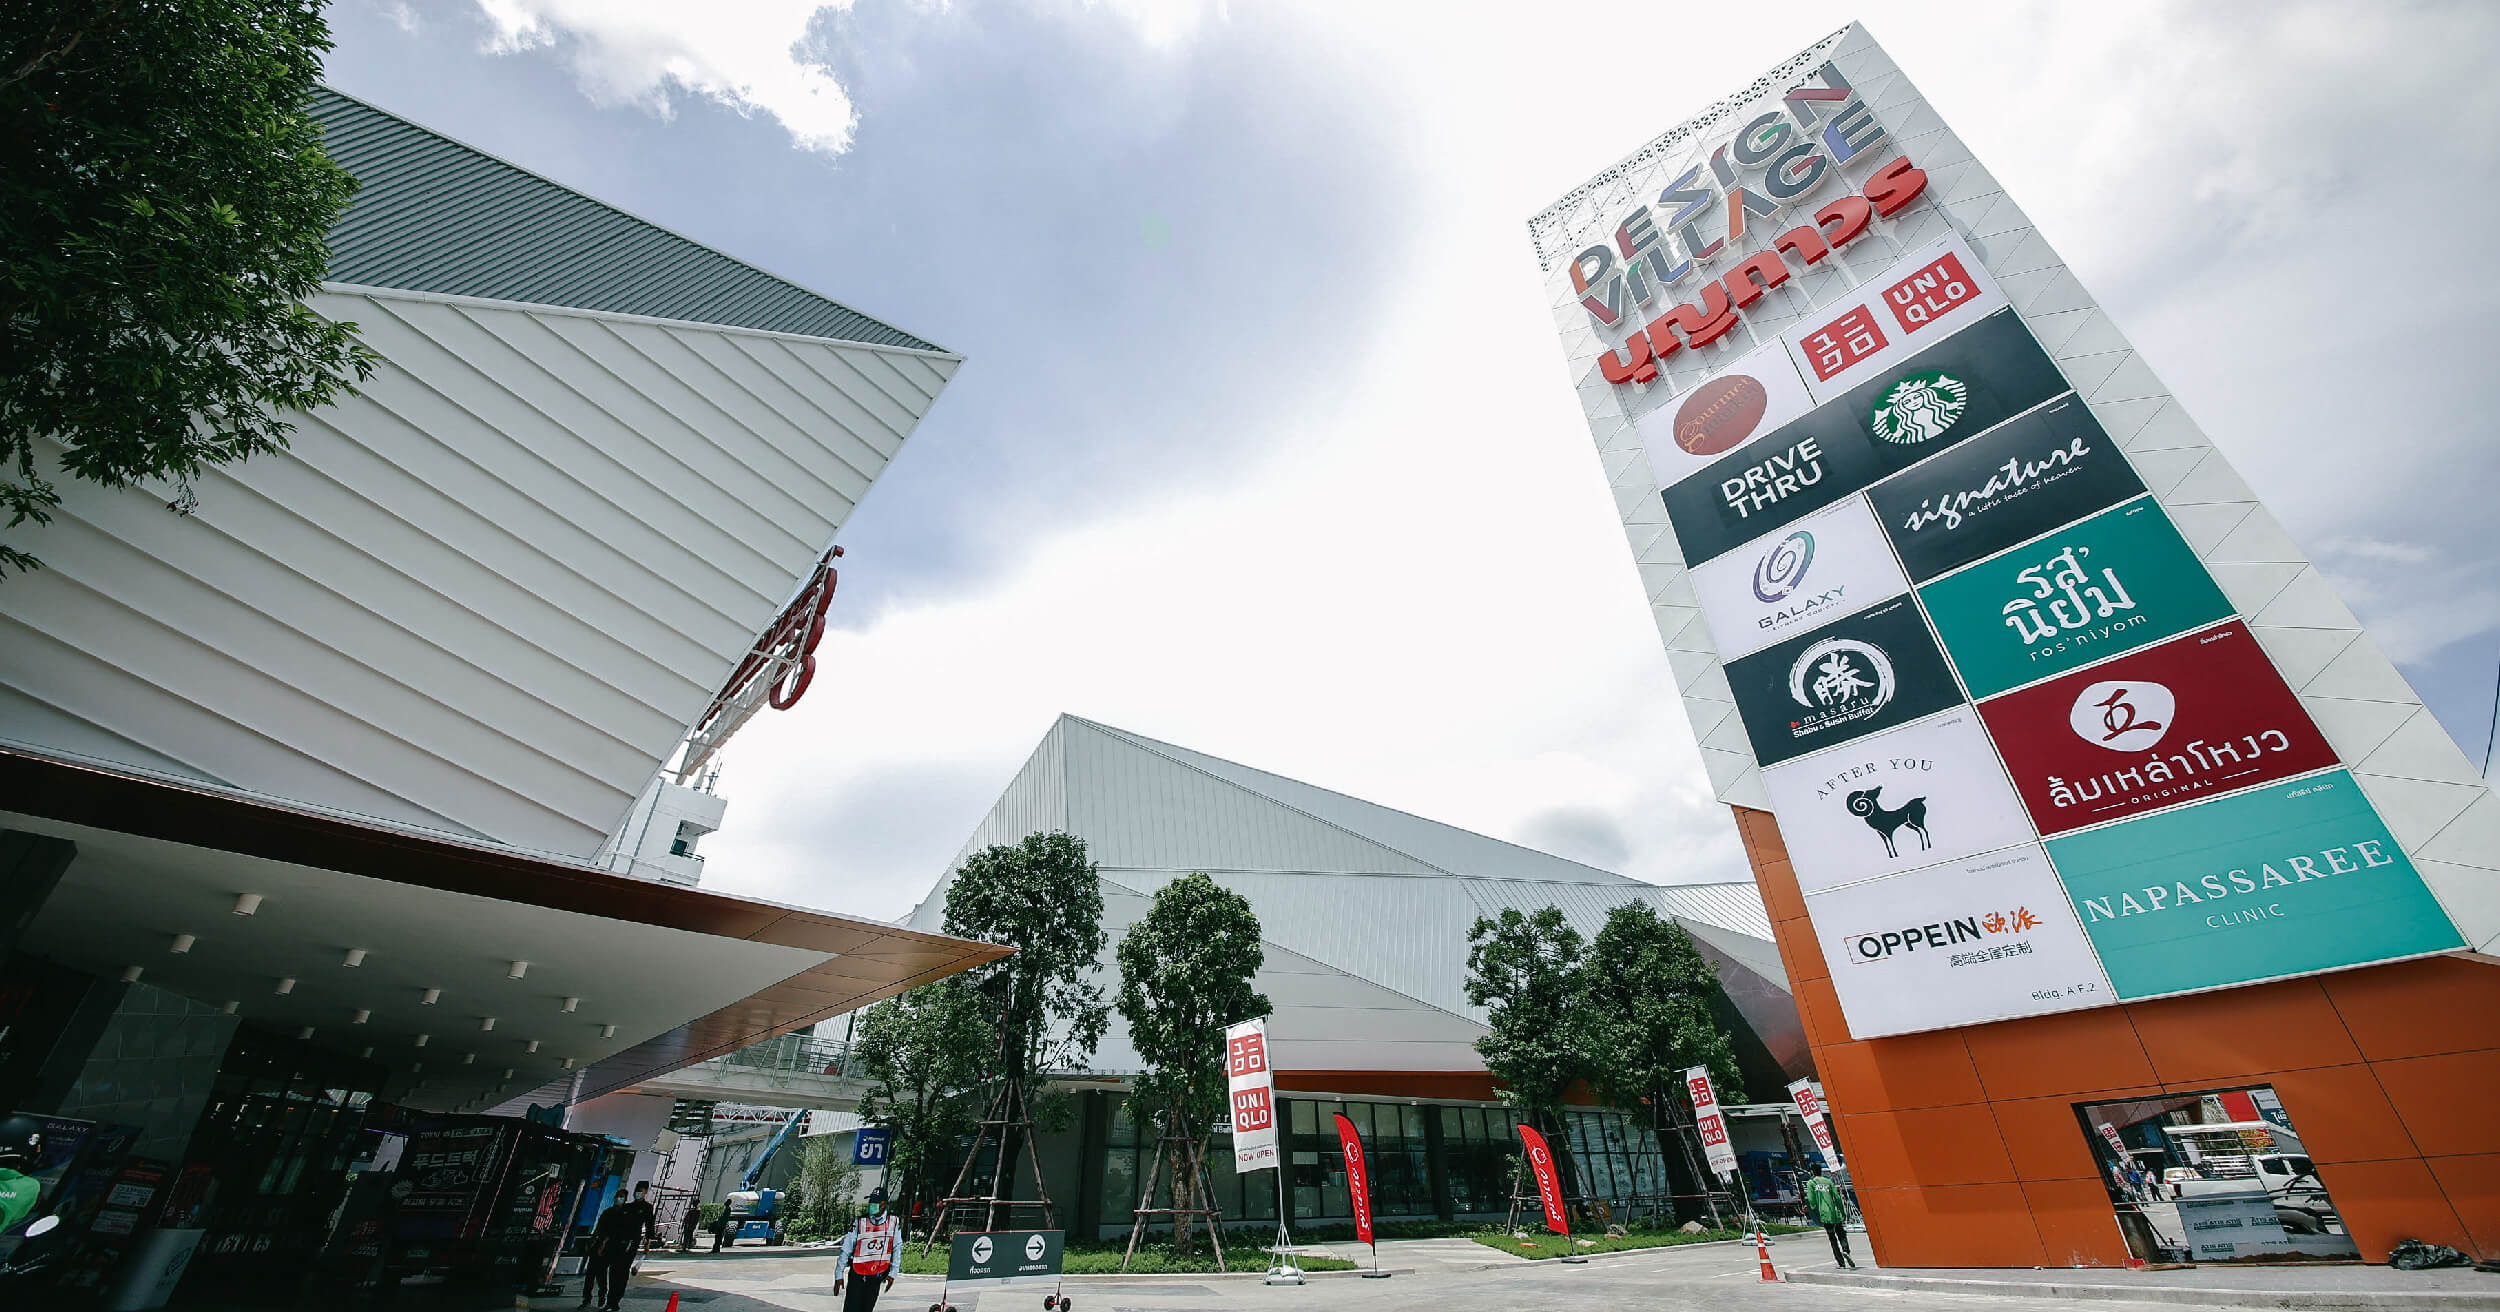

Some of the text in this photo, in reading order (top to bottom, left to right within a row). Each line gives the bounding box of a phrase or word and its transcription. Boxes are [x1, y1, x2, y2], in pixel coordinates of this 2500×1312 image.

[1568, 61, 1853, 296] DESIGN
[1578, 99, 1889, 328] VILLAGE
[1597, 155, 1929, 385] บุญถาวร
[1892, 264, 1951, 305] UNI
[1905, 281, 1967, 323] QLO
[1721, 436, 1823, 501] DRIVE
[1728, 460, 1823, 518] THRU
[1904, 437, 2091, 531] signature
[2030, 480, 2041, 490] of
[1758, 585, 1845, 629] GALAXY
[2002, 567, 2137, 645] นิยม
[2029, 613, 2148, 662] ros'niyom
[1793, 726, 1819, 738] Shabu
[1824, 715, 1848, 728] Sushi
[1848, 706, 1874, 720] Buffet
[1803, 697, 1869, 725] masaru
[1816, 758, 1934, 801] AFTER YOU
[2130, 778, 2213, 804] ORIGINAL
[2082, 839, 2394, 923] NAPASSAREE
[2205, 903, 2285, 929] CLINIC
[1858, 916, 1983, 958] OPPEIN
[2031, 989, 2063, 1000] Bldg.
[2067, 986, 2076, 995] A
[1237, 1092, 1265, 1110] UNI
[1239, 1109, 1268, 1128] QLO
[1700, 1118, 1717, 1131] UNI
[1705, 1129, 1722, 1144] QLO
[860, 1143, 883, 1159] ยา
[1238, 1149, 1274, 1162] NOW OPEN
